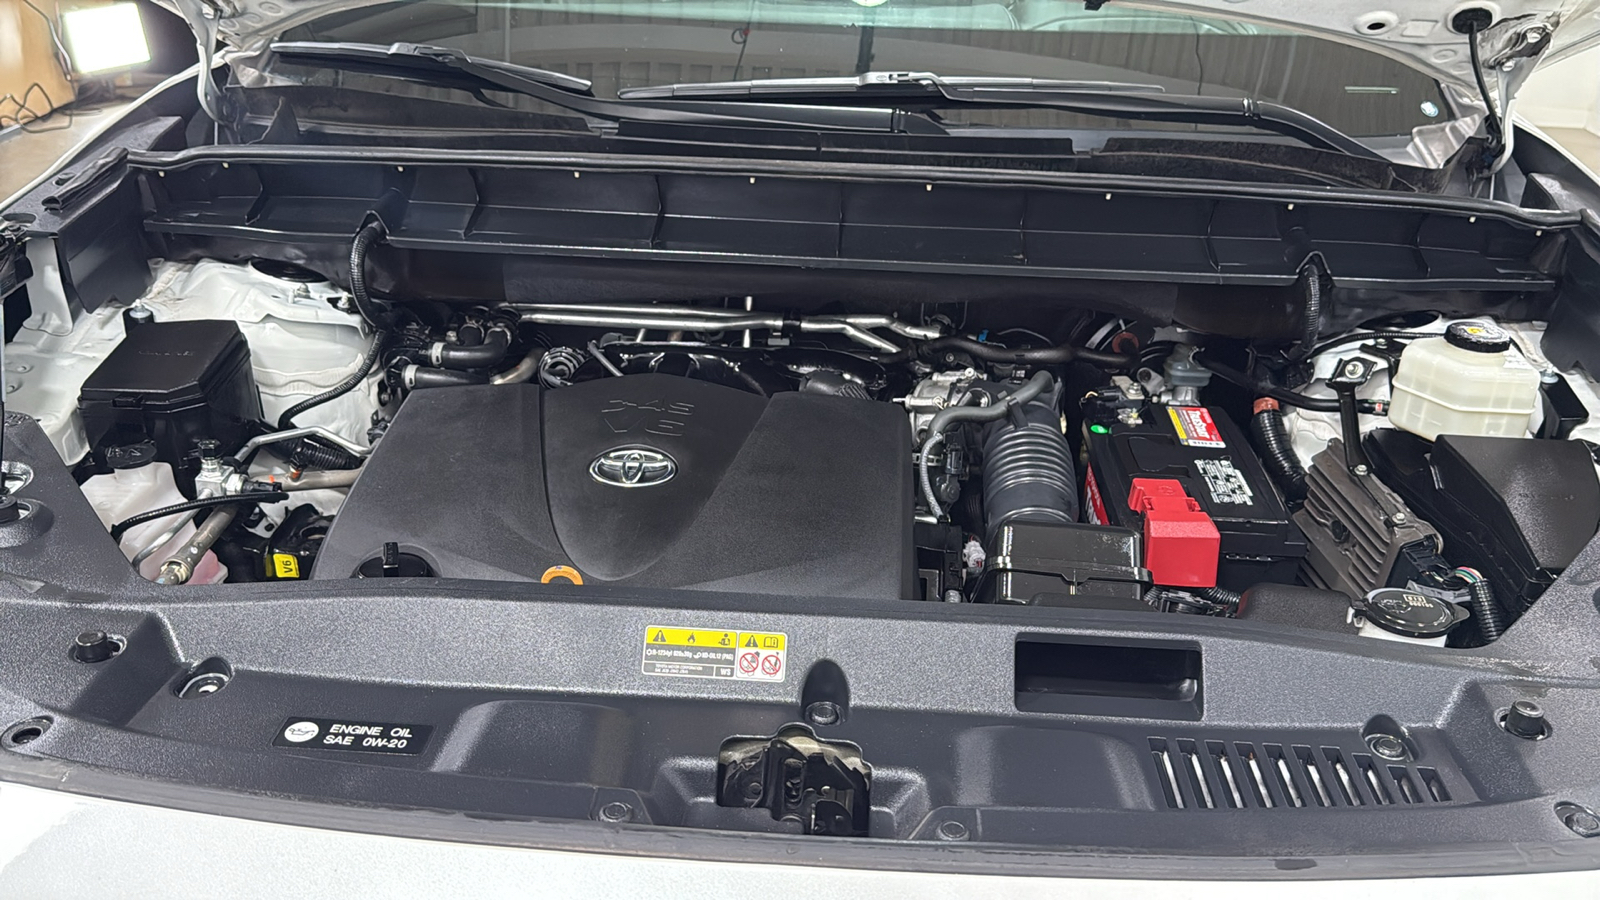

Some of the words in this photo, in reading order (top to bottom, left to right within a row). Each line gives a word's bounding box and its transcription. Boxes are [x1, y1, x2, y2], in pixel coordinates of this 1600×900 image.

[283, 560, 293, 573] V6
[329, 723, 383, 736] ENGINE
[390, 727, 413, 738] OIL
[323, 735, 354, 745] SAE
[362, 737, 407, 748] 0W-20
